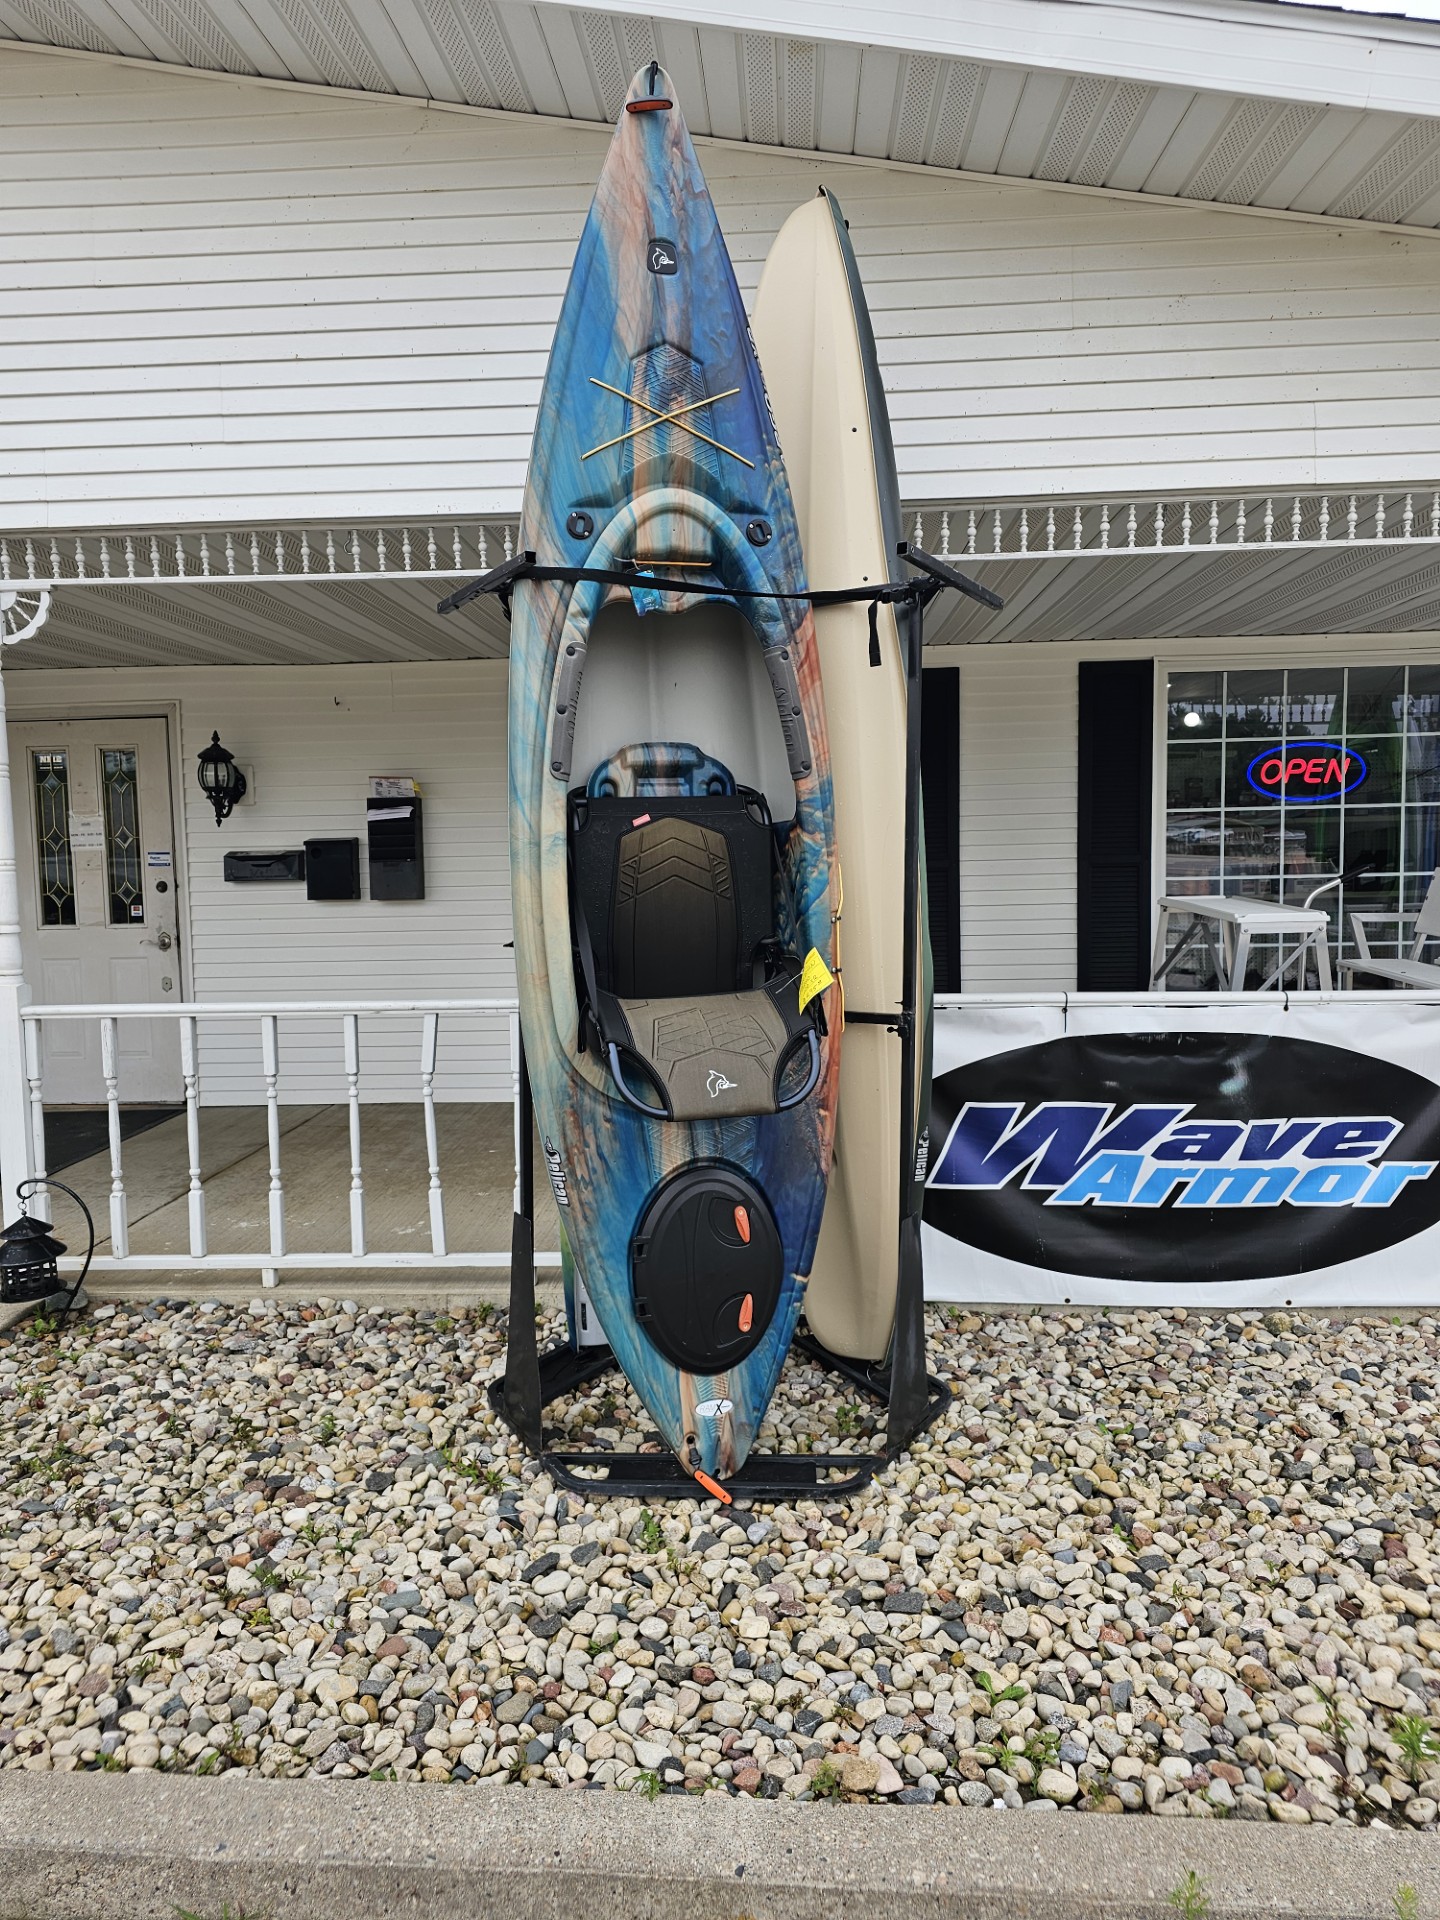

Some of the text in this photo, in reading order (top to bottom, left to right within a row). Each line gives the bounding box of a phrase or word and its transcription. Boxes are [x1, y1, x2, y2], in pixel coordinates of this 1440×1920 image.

[1260, 758, 1351, 785] OPEN
[914, 1137, 930, 1182] Pelican
[925, 1102, 1405, 1190] Wave
[545, 1147, 570, 1207] Pelican
[1043, 1149, 1439, 1208] Armor
